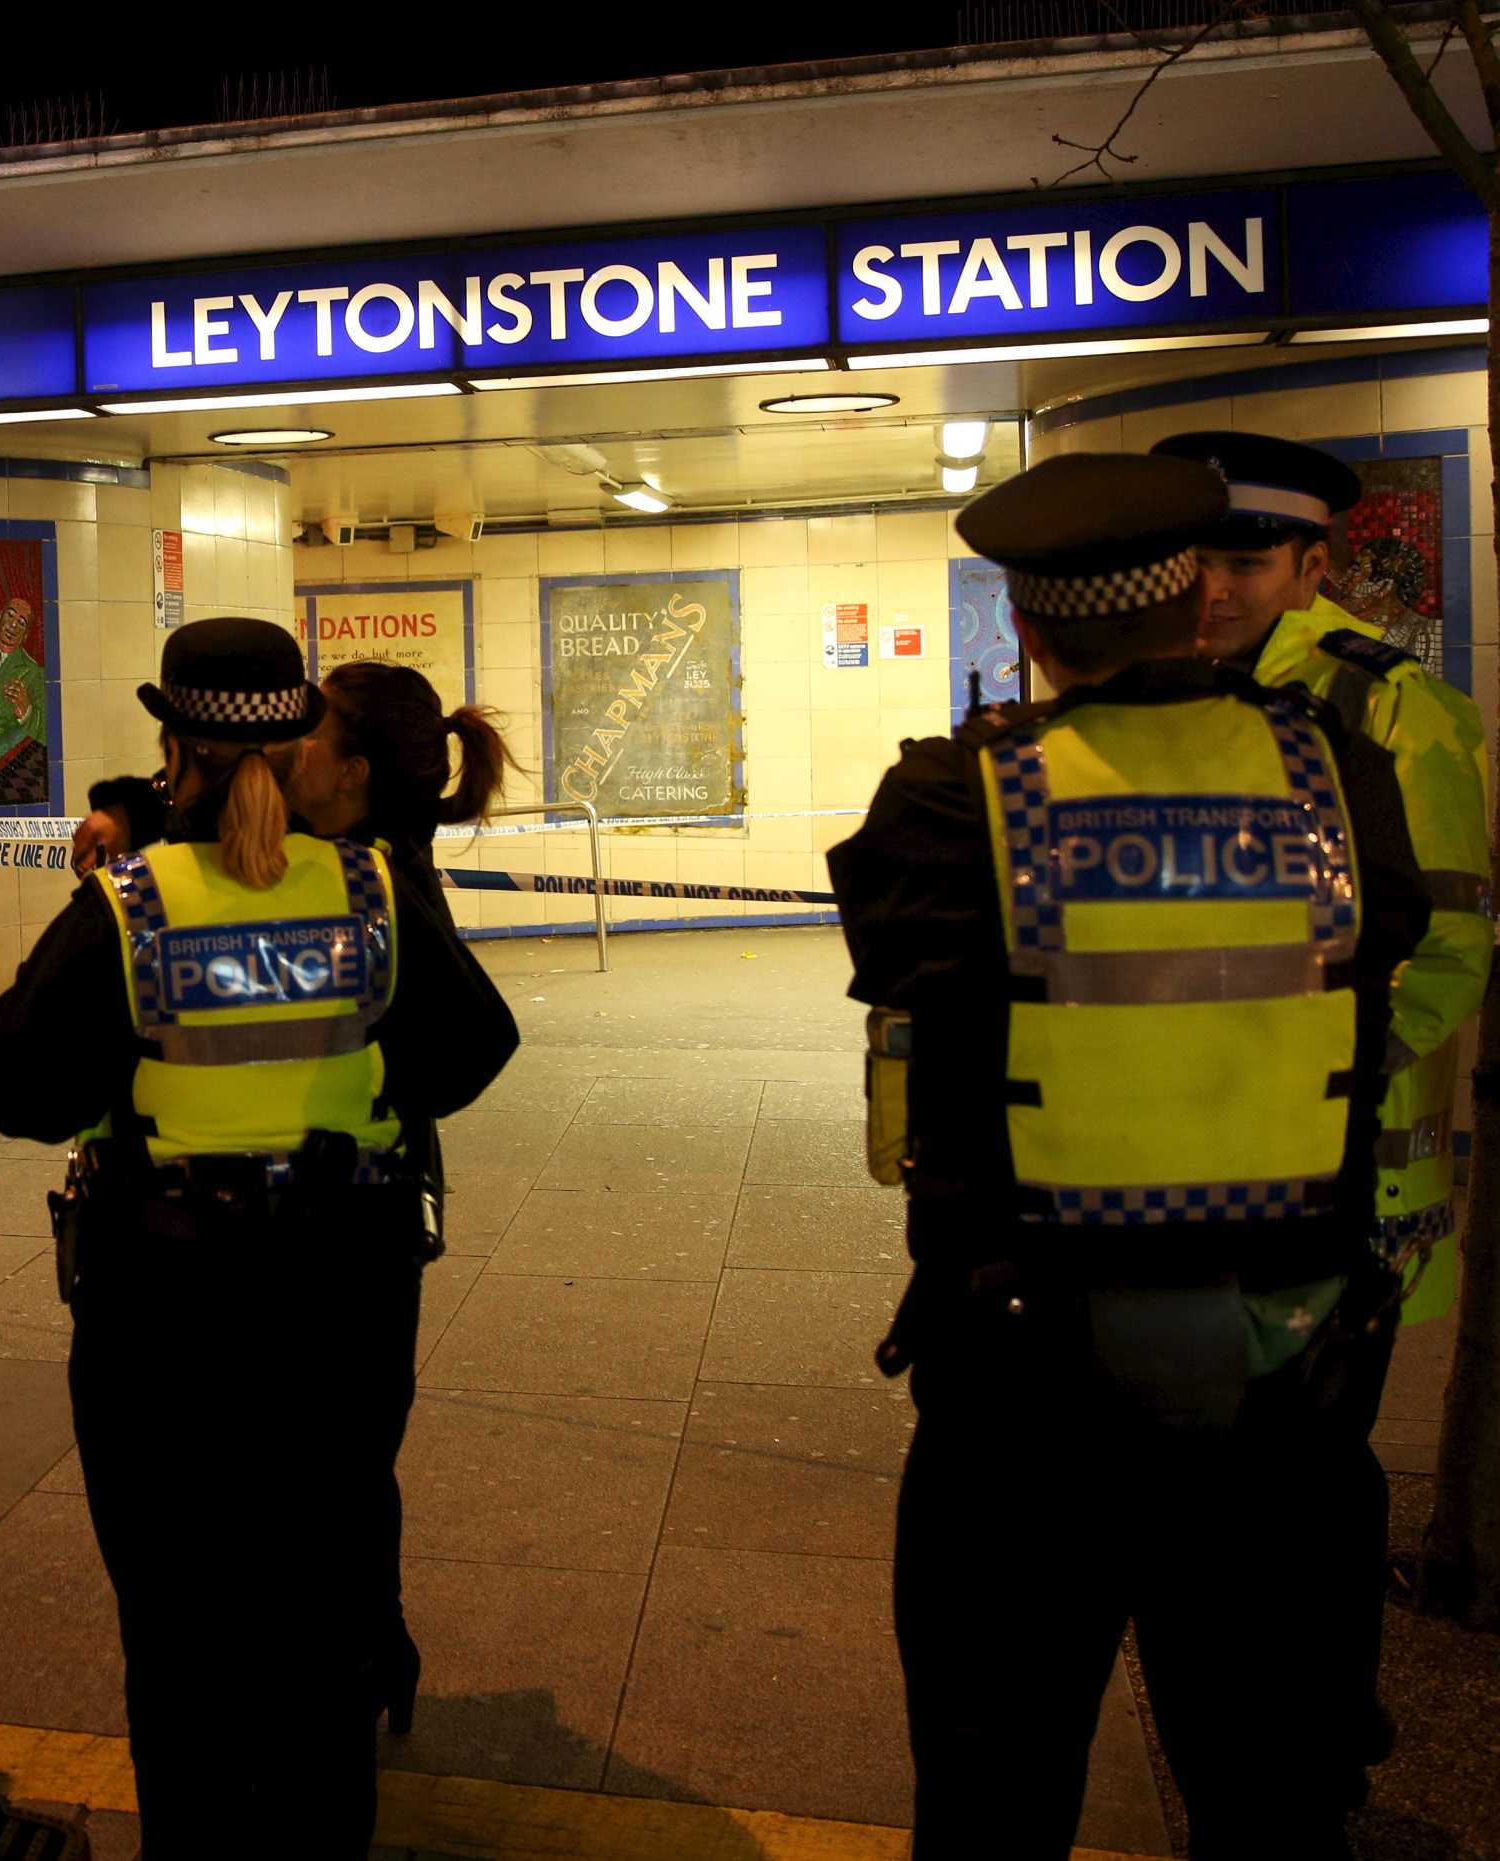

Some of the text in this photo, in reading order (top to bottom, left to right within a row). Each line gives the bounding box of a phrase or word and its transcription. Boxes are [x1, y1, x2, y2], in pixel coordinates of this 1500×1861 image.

[149, 217, 1265, 369] LEYTONSTONE STATION
[559, 611, 658, 633] QUALITY
[396, 650, 423, 659] more
[560, 636, 640, 657] BREAD
[562, 593, 707, 802] CHAPMAN'S
[626, 766, 664, 785] High
[619, 785, 709, 801] CATERING
[1058, 808, 1303, 829] BRITISH TRANSPORT
[13, 841, 43, 869] LINE
[46, 845, 67, 869] DO
[1058, 834, 1313, 888] POLICE
[168, 926, 357, 956] BRITISH TRANSPORT
[170, 949, 358, 1000] POLICE
